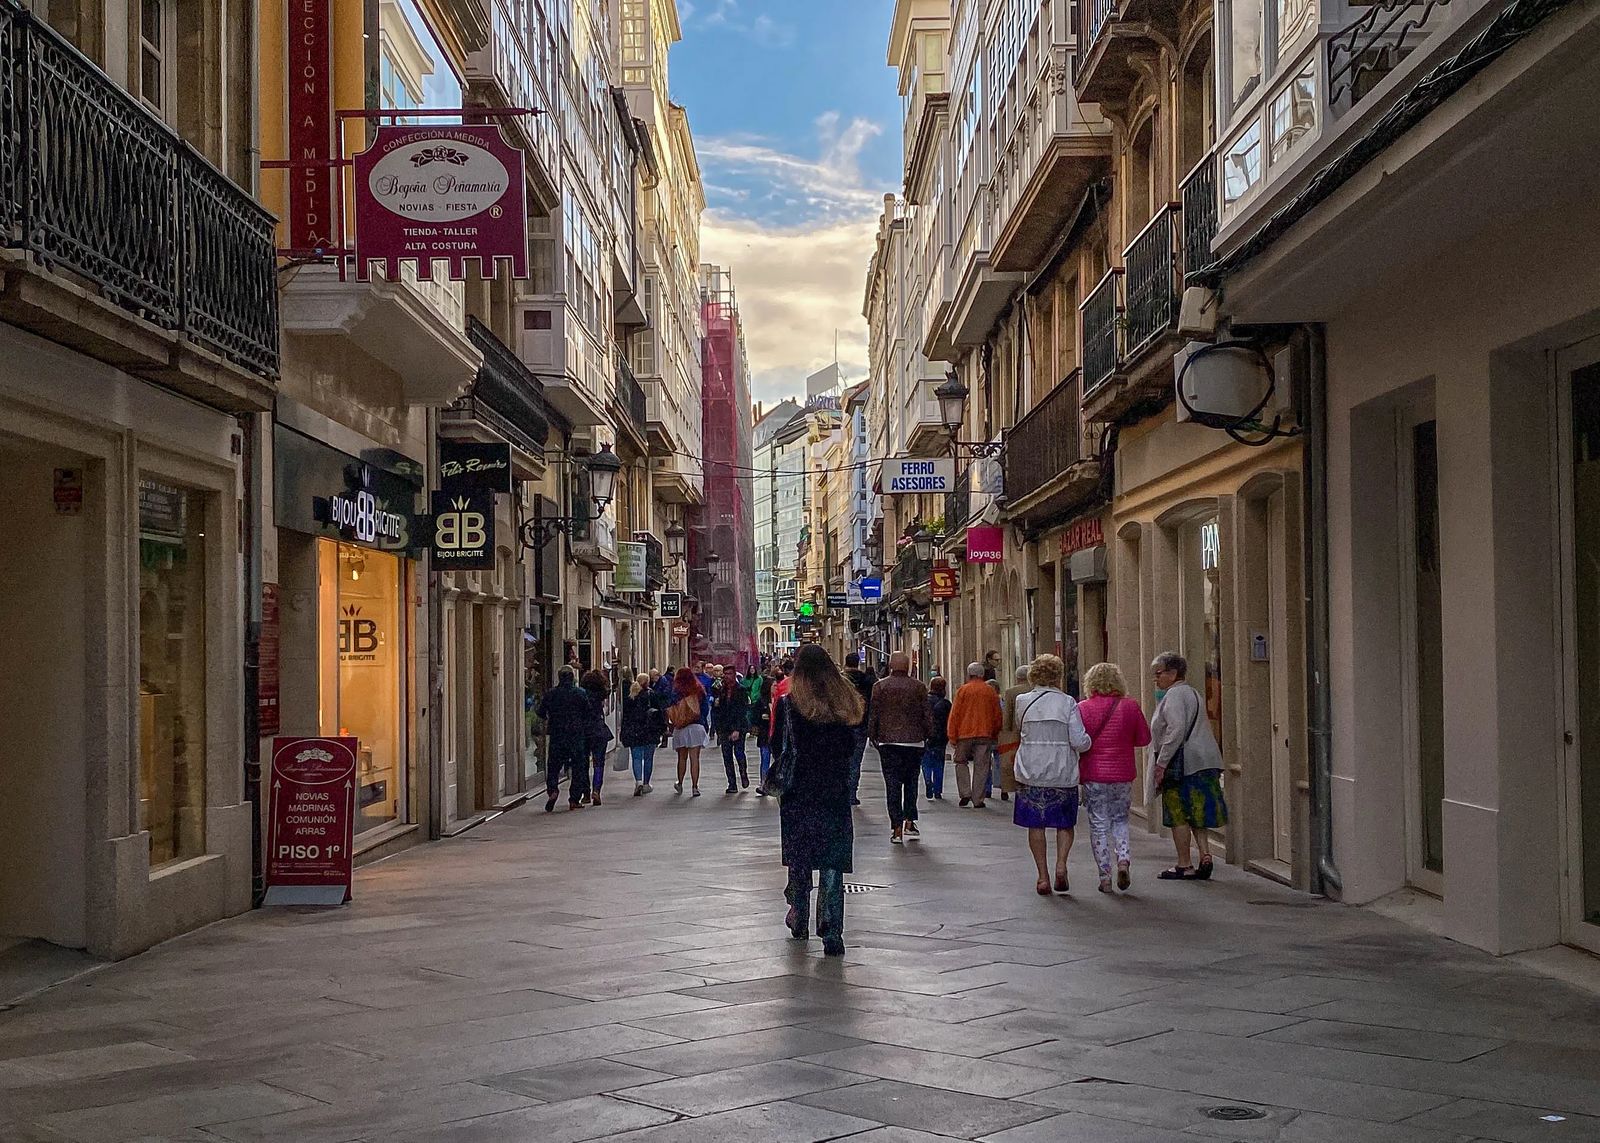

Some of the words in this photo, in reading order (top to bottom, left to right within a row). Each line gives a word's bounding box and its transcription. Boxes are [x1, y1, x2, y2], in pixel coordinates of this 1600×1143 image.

[383, 129, 444, 152] CONFECCIÓN
[446, 131, 453, 139] A
[454, 131, 490, 149] MEDIDA
[376, 174, 427, 199] Begoña
[399, 203, 434, 212] NOVIAS
[446, 203, 478, 211] FIESTA
[405, 242, 427, 250] ALTA
[432, 241, 477, 250] COSTURA
[901, 462, 935, 475] FERRO
[891, 477, 945, 491] ASESORES
[332, 496, 357, 530] BIJOU
[437, 551, 455, 559] BIJOU
[457, 550, 484, 558] BRIGITTE
[969, 549, 1001, 559] joya36
[296, 793, 329, 801] NOVIAS
[288, 804, 335, 812] MADRINAS
[286, 815, 336, 824] COMUNIÓN
[295, 827, 326, 835] ARRAS
[279, 845, 320, 859] PISO
